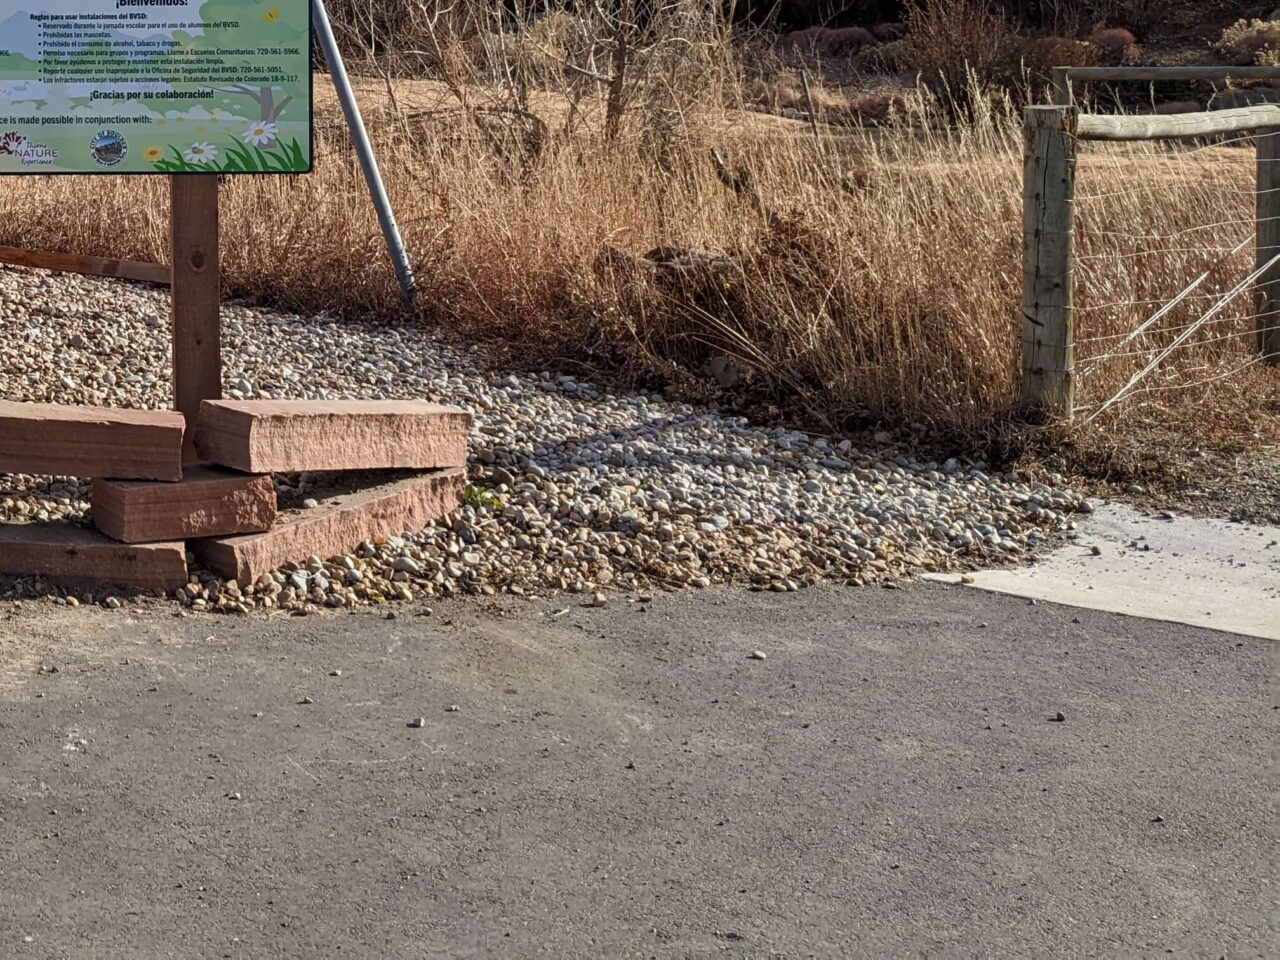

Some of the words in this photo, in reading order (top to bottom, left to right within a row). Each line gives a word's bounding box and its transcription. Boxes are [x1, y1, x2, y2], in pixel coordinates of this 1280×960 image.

[127, 92, 141, 100] por
[155, 89, 214, 99] colaboración!
[10, 116, 16, 124] is
[18, 116, 40, 124] made
[42, 116, 74, 125] possible
[76, 115, 83, 124] in
[84, 115, 131, 125] conjunction
